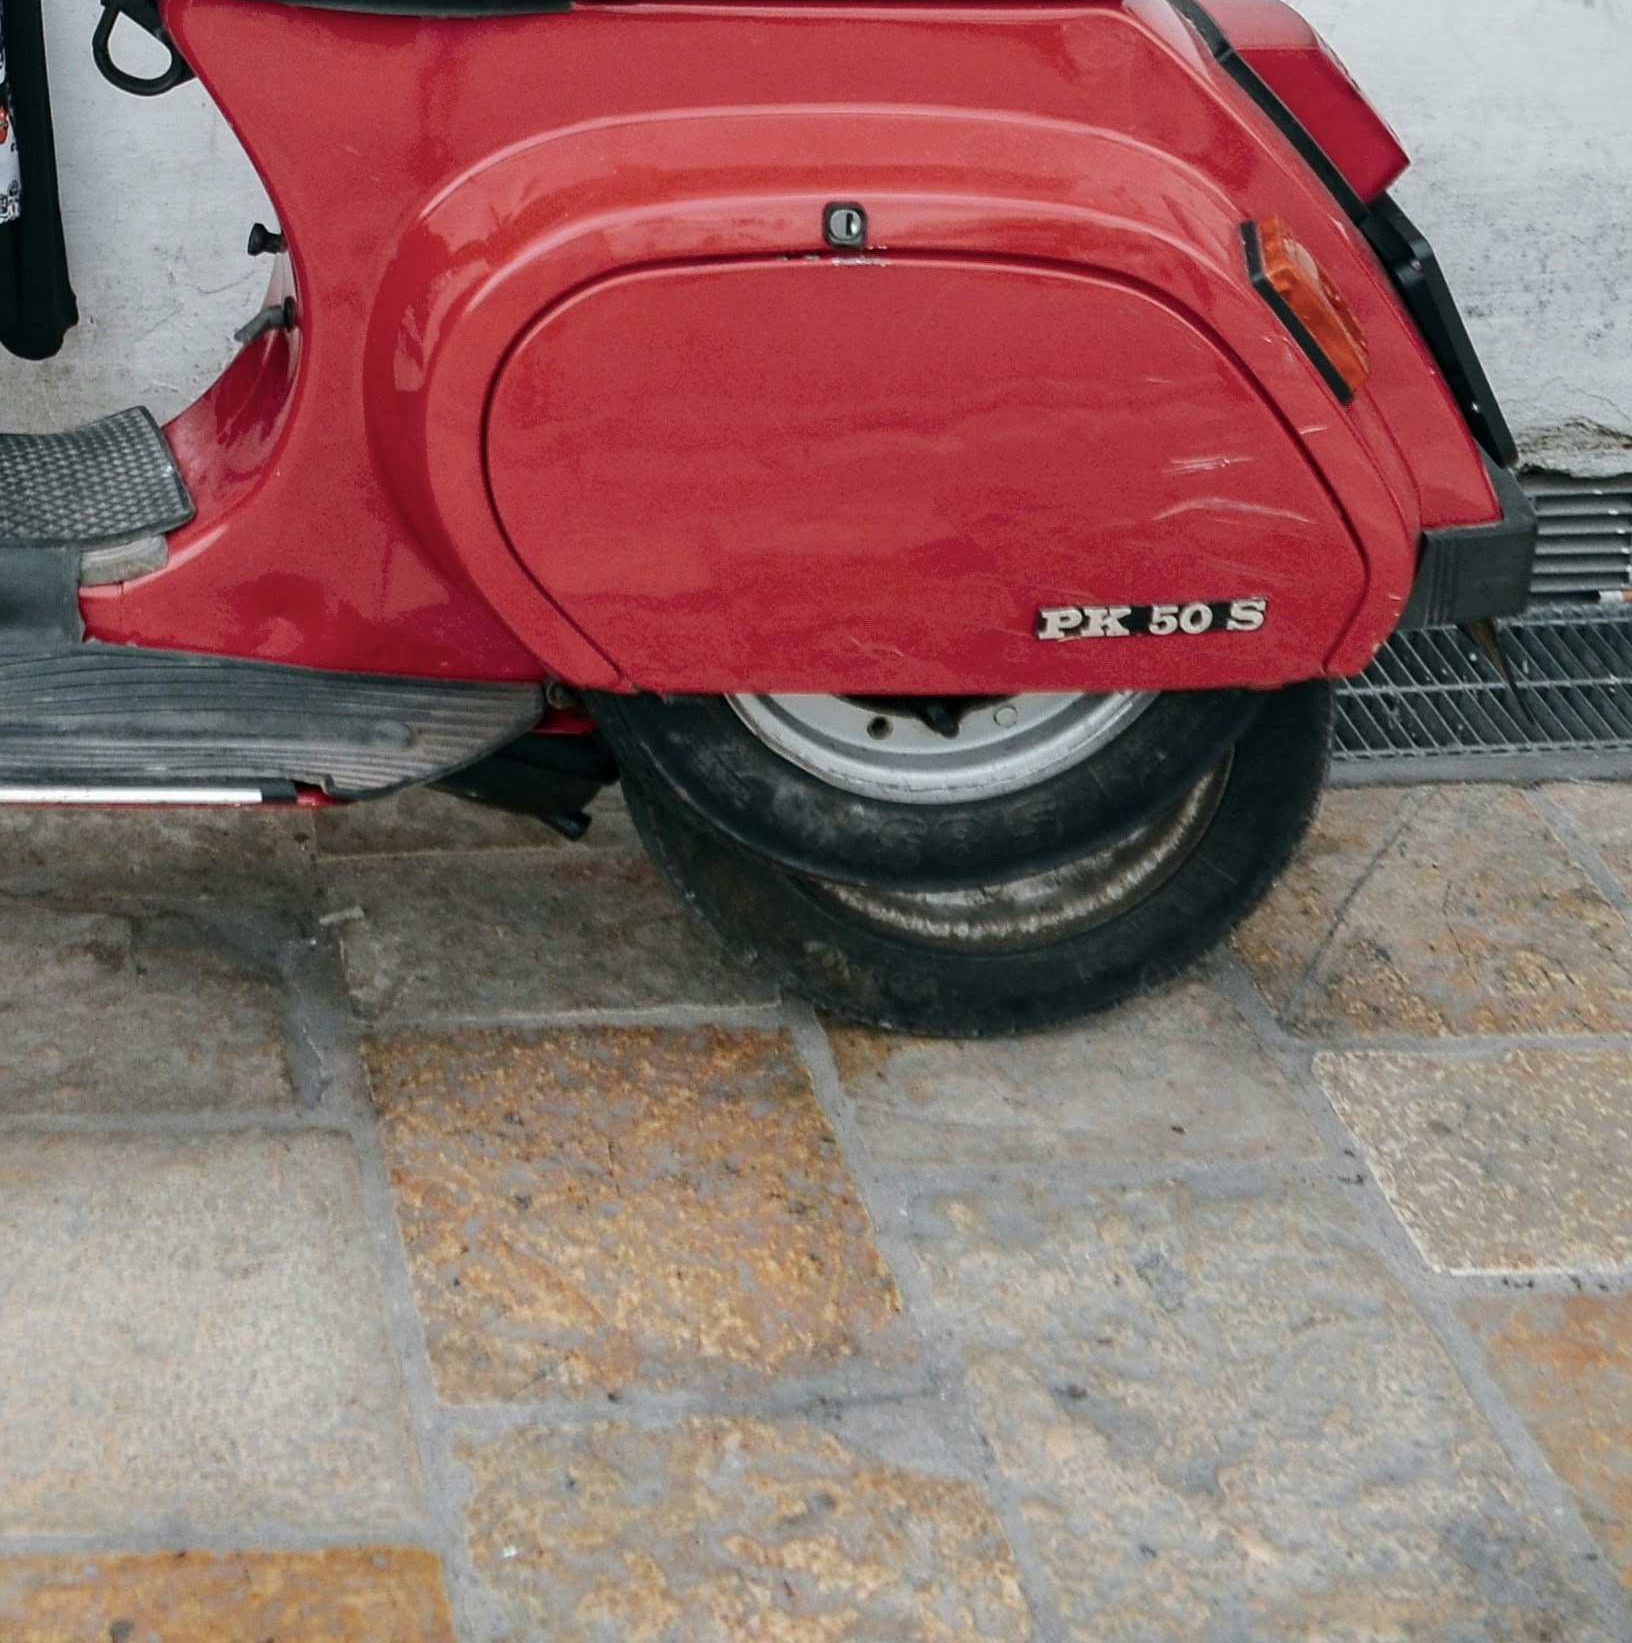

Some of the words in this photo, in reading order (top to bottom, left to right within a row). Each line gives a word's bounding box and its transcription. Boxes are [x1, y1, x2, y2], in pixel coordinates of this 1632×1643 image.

[1038, 605, 1131, 640] PK
[1147, 602, 1213, 635] 50
[1225, 598, 1268, 631] S
